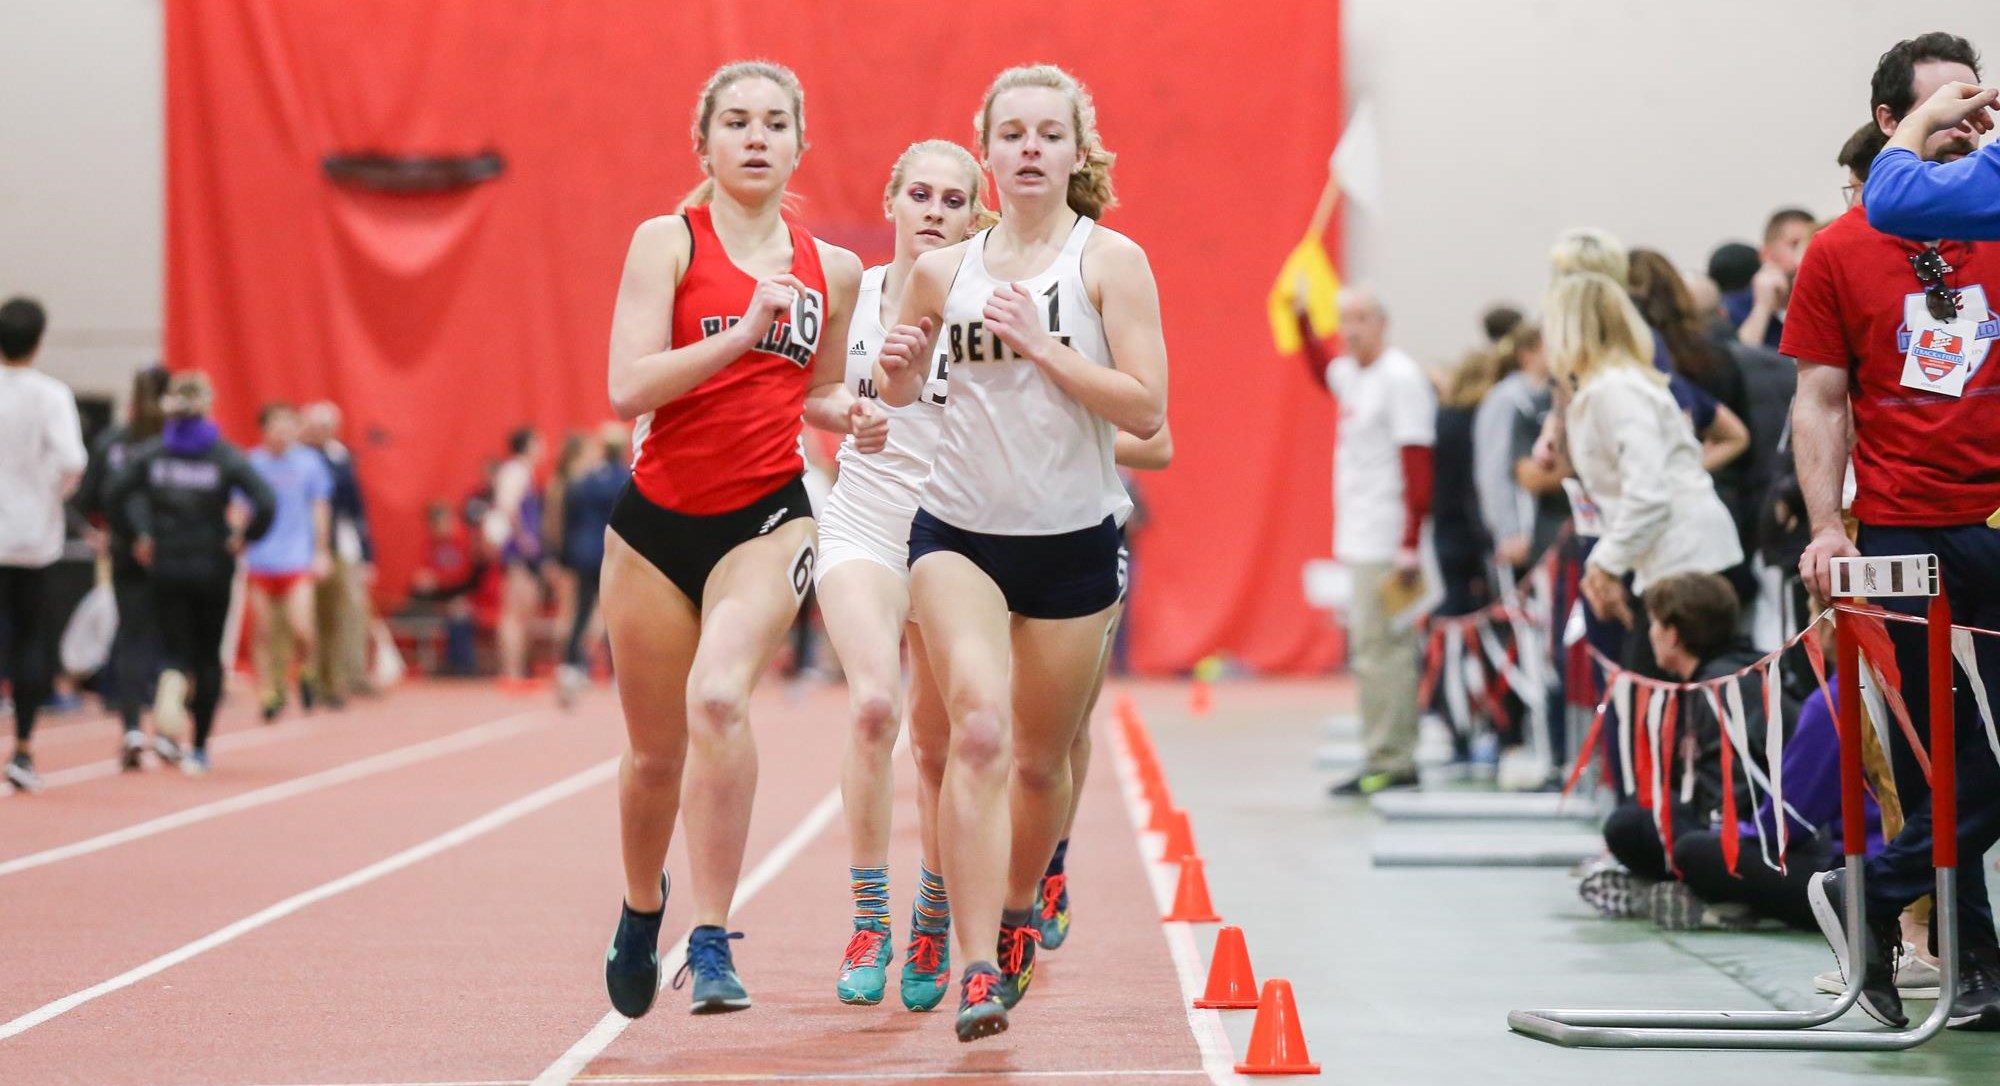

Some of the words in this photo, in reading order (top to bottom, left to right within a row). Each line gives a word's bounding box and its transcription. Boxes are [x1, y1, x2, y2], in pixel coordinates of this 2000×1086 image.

[796, 293, 818, 345] 6
[1042, 281, 1060, 332] 1
[793, 546, 814, 595] 6
